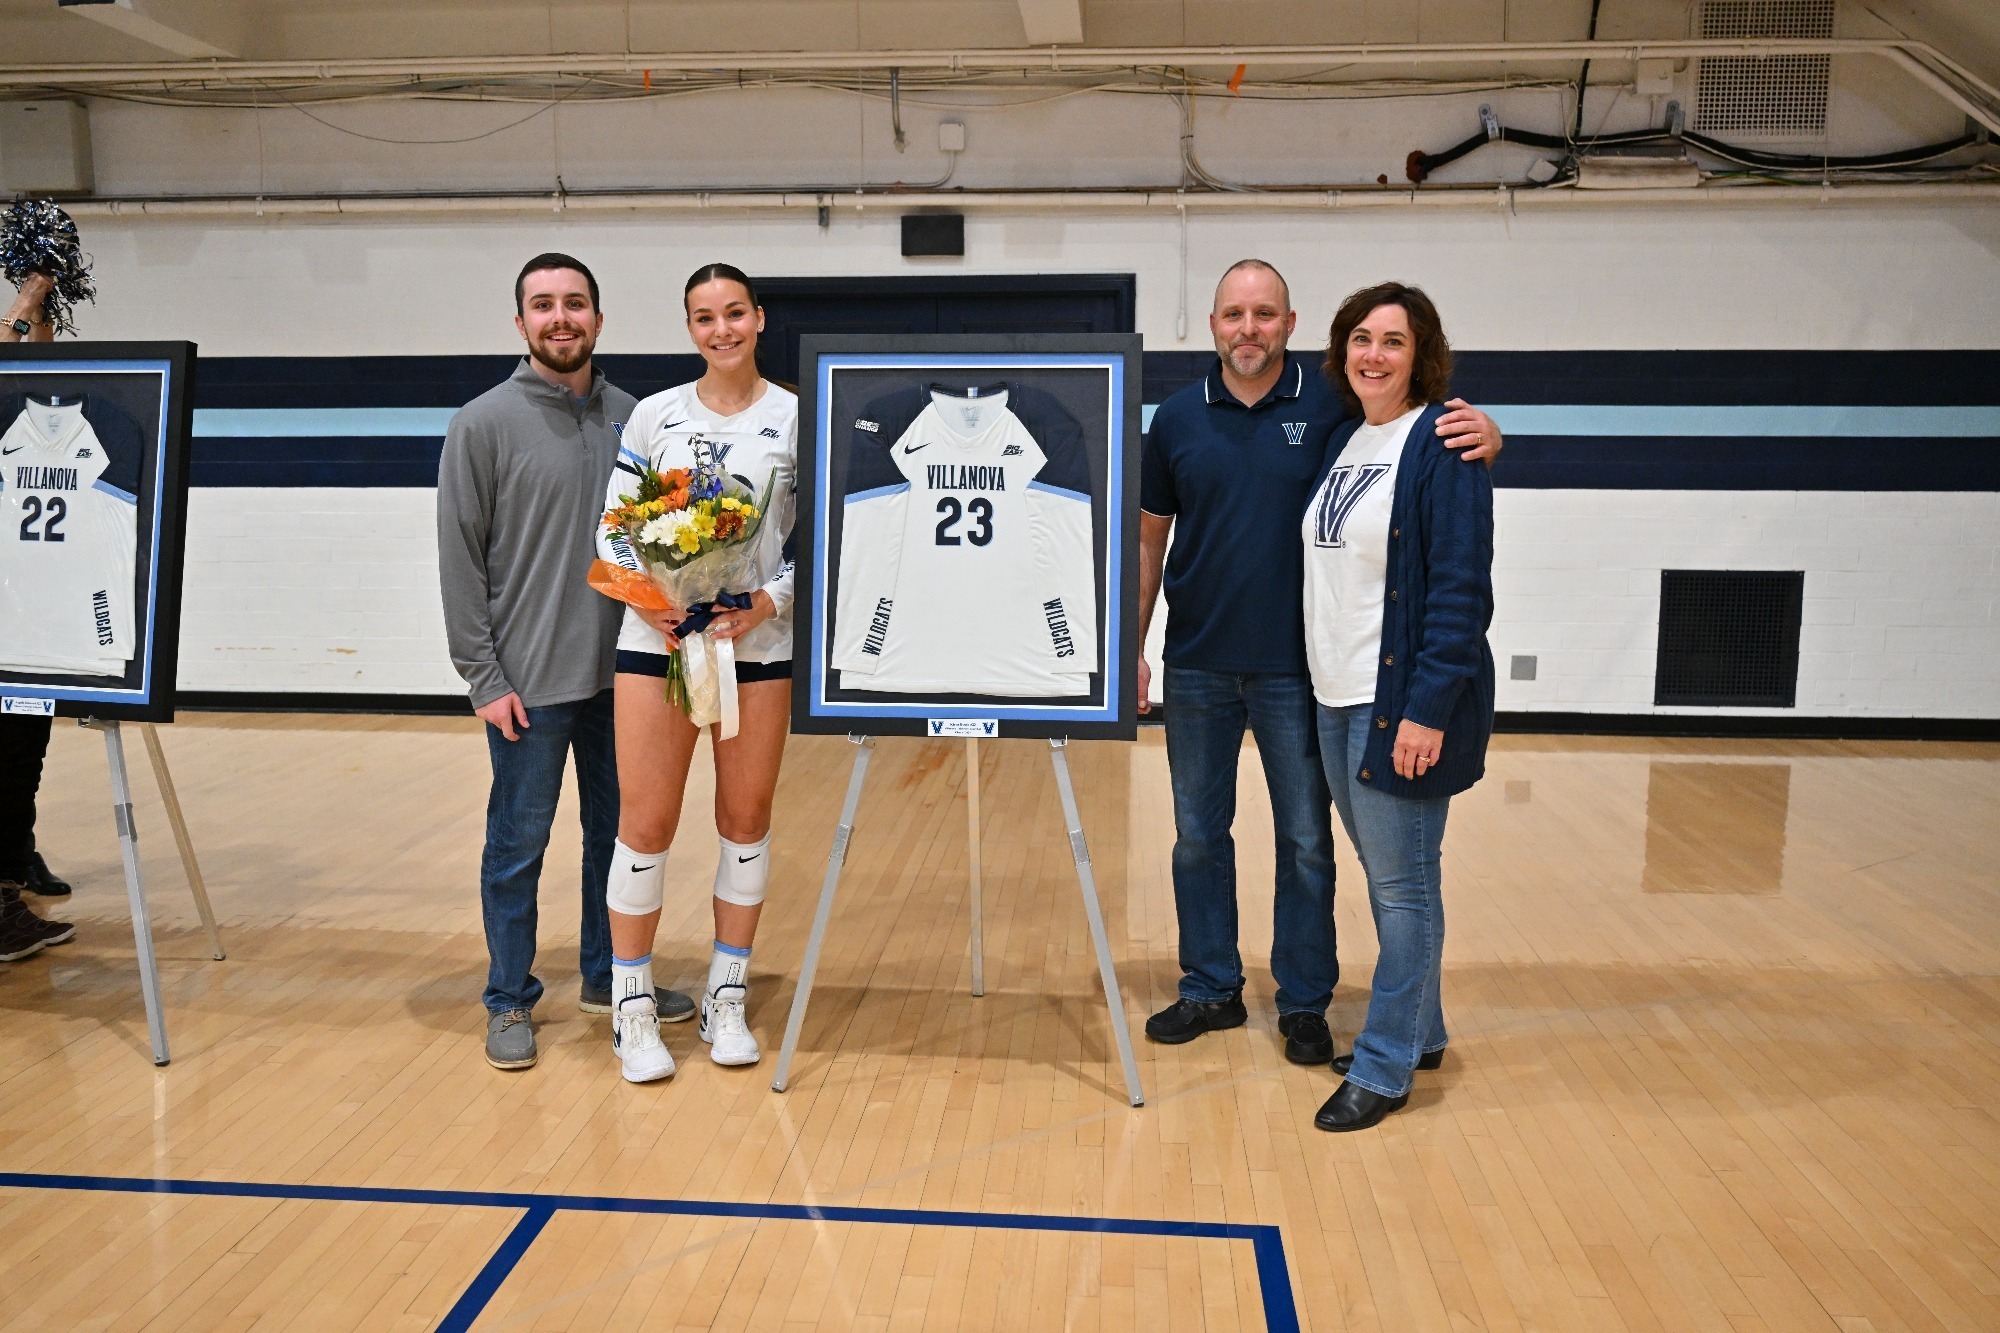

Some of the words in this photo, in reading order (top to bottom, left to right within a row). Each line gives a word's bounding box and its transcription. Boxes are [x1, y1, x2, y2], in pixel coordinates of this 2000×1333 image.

[1282, 422, 1307, 445] V
[16, 466, 78, 490] VILLANOVA
[926, 465, 1006, 491] VILLANOVA
[20, 495, 67, 542] 22
[935, 496, 994, 547] 23
[1314, 463, 1393, 548] V
[92, 590, 114, 646] WILDCATS
[861, 597, 893, 656] WILDCATS
[1042, 597, 1075, 658] WILDCATS
